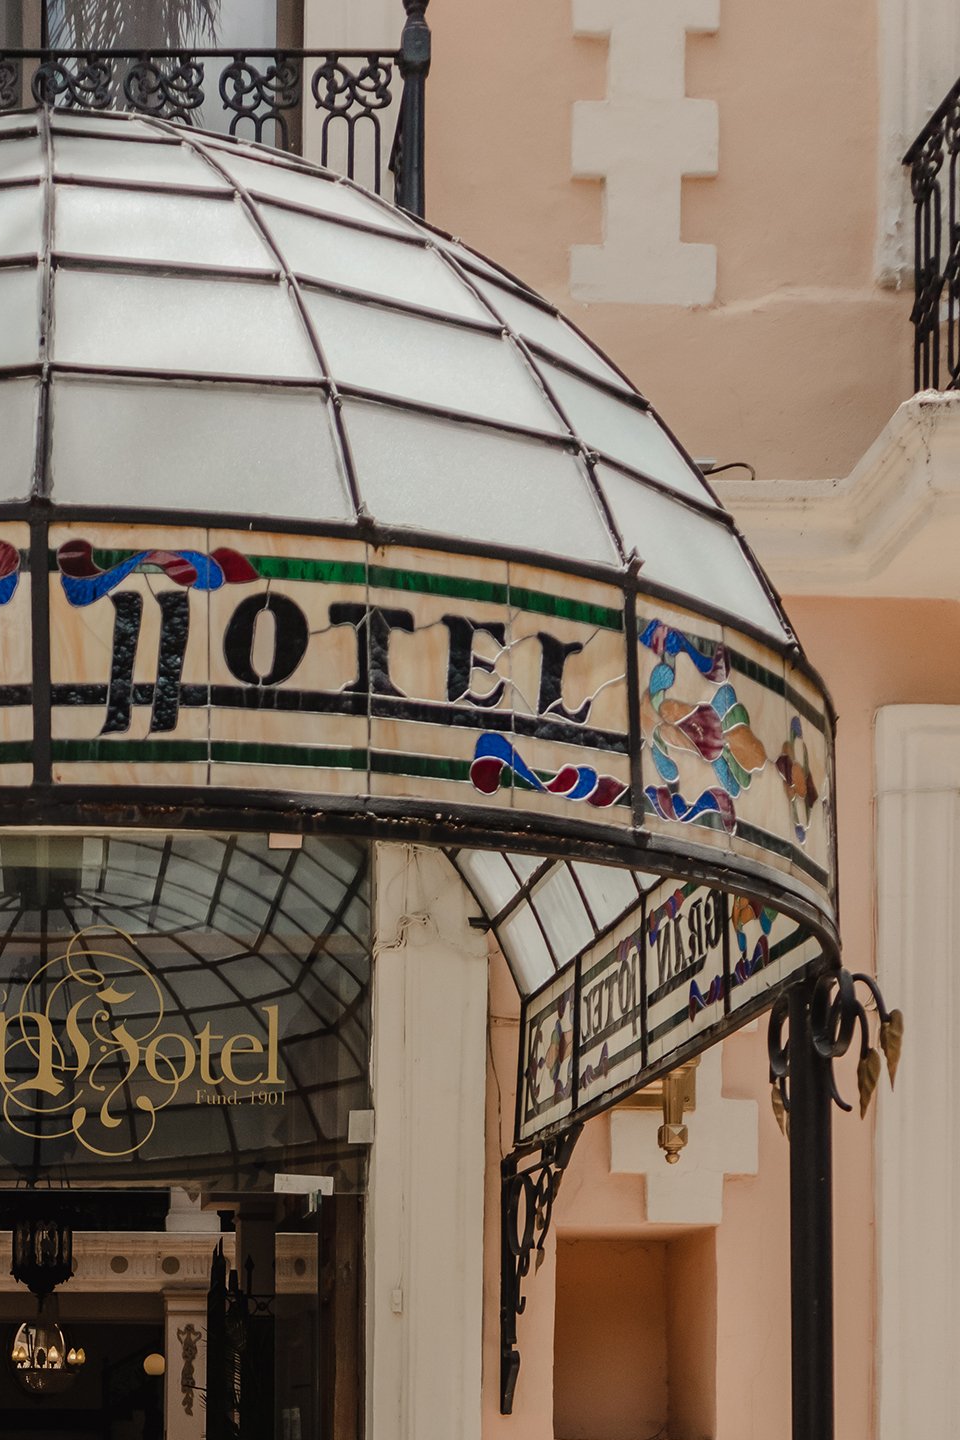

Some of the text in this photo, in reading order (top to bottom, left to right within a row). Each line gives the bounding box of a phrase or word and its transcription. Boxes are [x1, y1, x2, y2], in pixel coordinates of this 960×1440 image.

[99, 590, 595, 736] HOTEL
[195, 1089, 285, 1105] Fund. 1901
